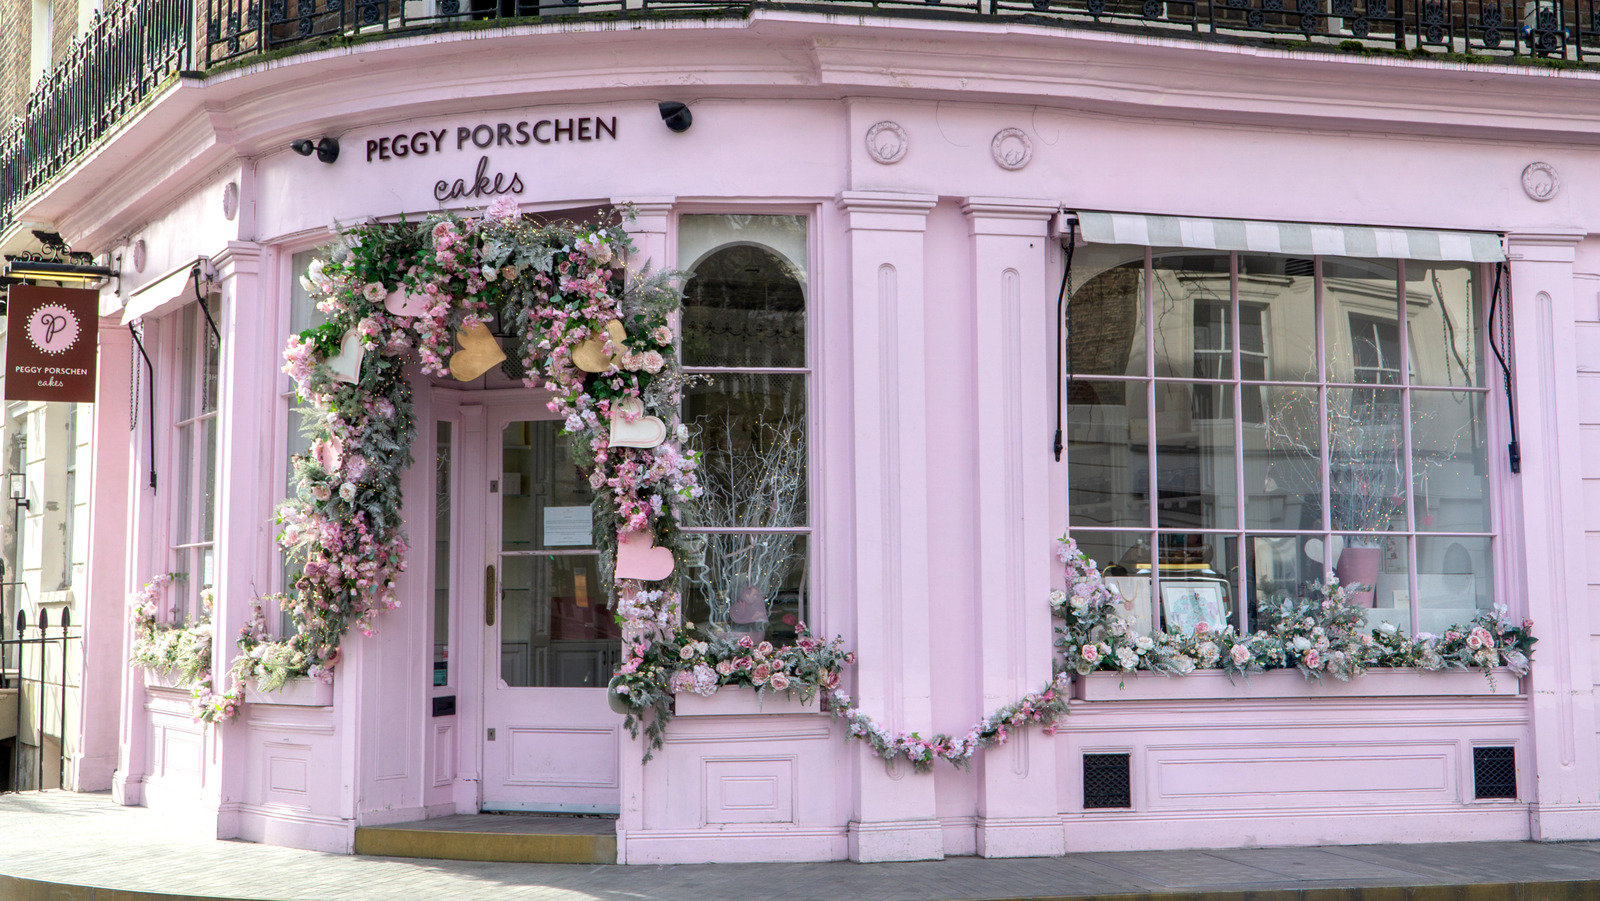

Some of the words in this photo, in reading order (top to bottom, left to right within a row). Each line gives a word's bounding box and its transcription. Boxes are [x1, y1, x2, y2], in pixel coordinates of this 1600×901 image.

[366, 129, 446, 162] PEGGY
[457, 116, 617, 149] PORSCHEN
[434, 156, 524, 201] cakes
[15, 366, 42, 374] PEGGY
[44, 367, 88, 375] PORSCHEN
[37, 376, 64, 387] cakes
